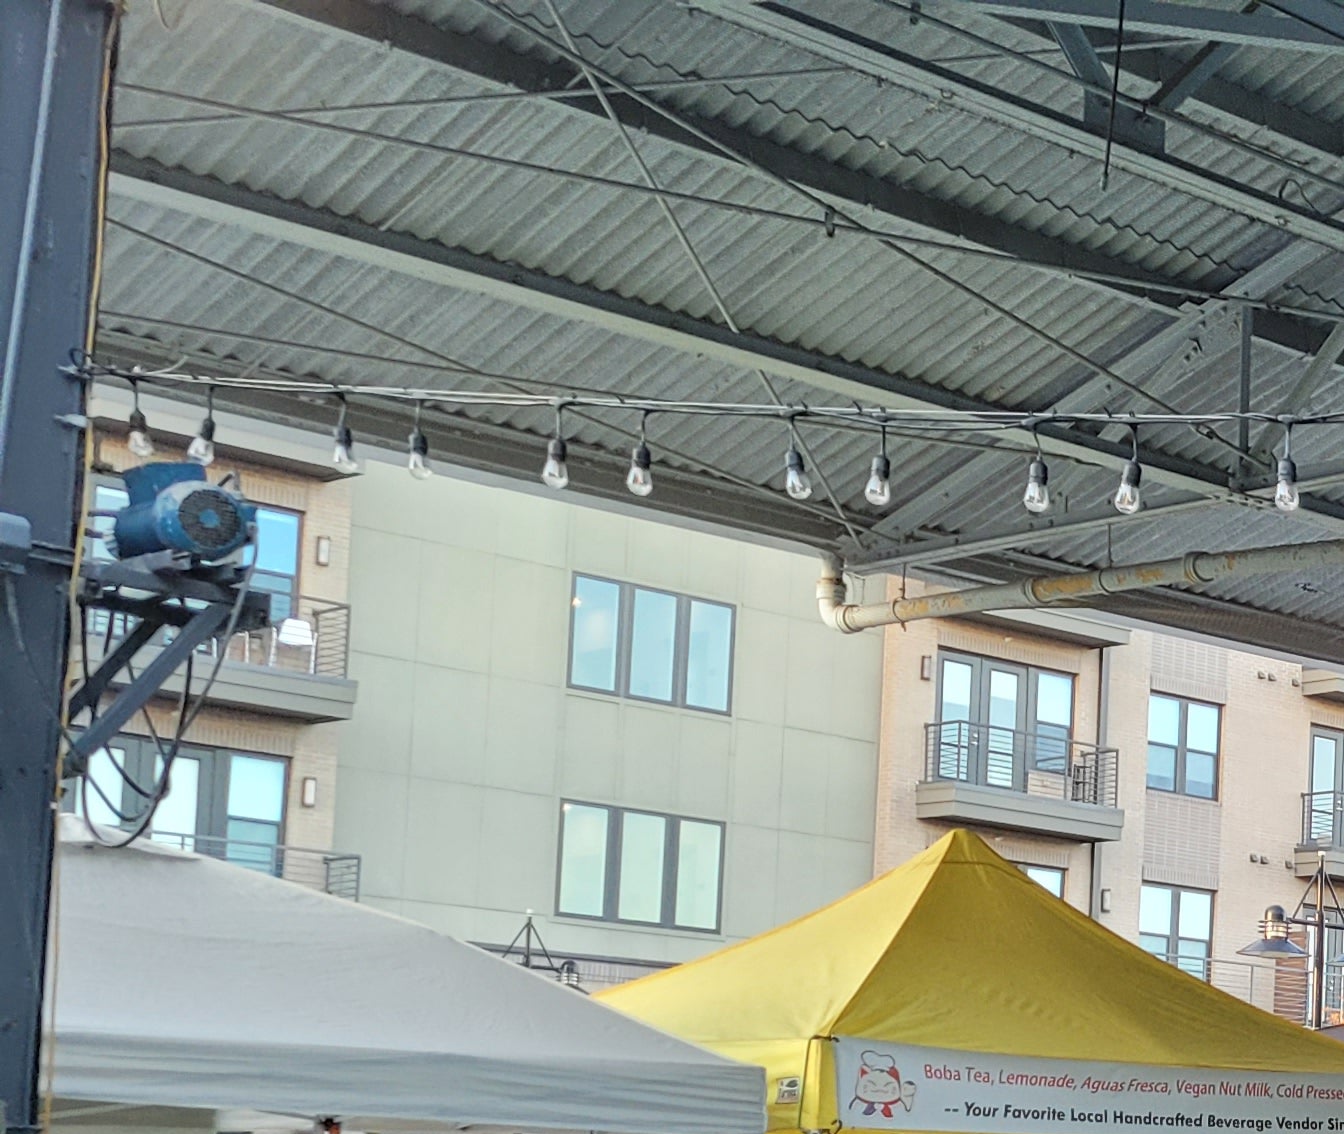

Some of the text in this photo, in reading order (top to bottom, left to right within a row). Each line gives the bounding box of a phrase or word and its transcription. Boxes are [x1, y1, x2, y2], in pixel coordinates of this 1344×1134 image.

[924, 1064, 961, 1081] Boba
[965, 1067, 995, 1085] Tea,
[999, 1070, 1077, 1090] Lemonade,
[1081, 1076, 1126, 1094] Aguas
[1128, 1078, 1172, 1096] Fresca,
[1176, 1080, 1216, 1098] Vegan
[1219, 1081, 1242, 1096] Nut
[1245, 1082, 1274, 1099] Milk,
[1276, 1084, 1303, 1099] Cold
[964, 1102, 999, 1119] Your
[1003, 1104, 1066, 1122] Favorite
[1070, 1107, 1108, 1124] Local
[1113, 1110, 1203, 1128] Handcrafted
[1208, 1115, 1272, 1132] Beverage
[1276, 1117, 1324, 1132] Vendor
